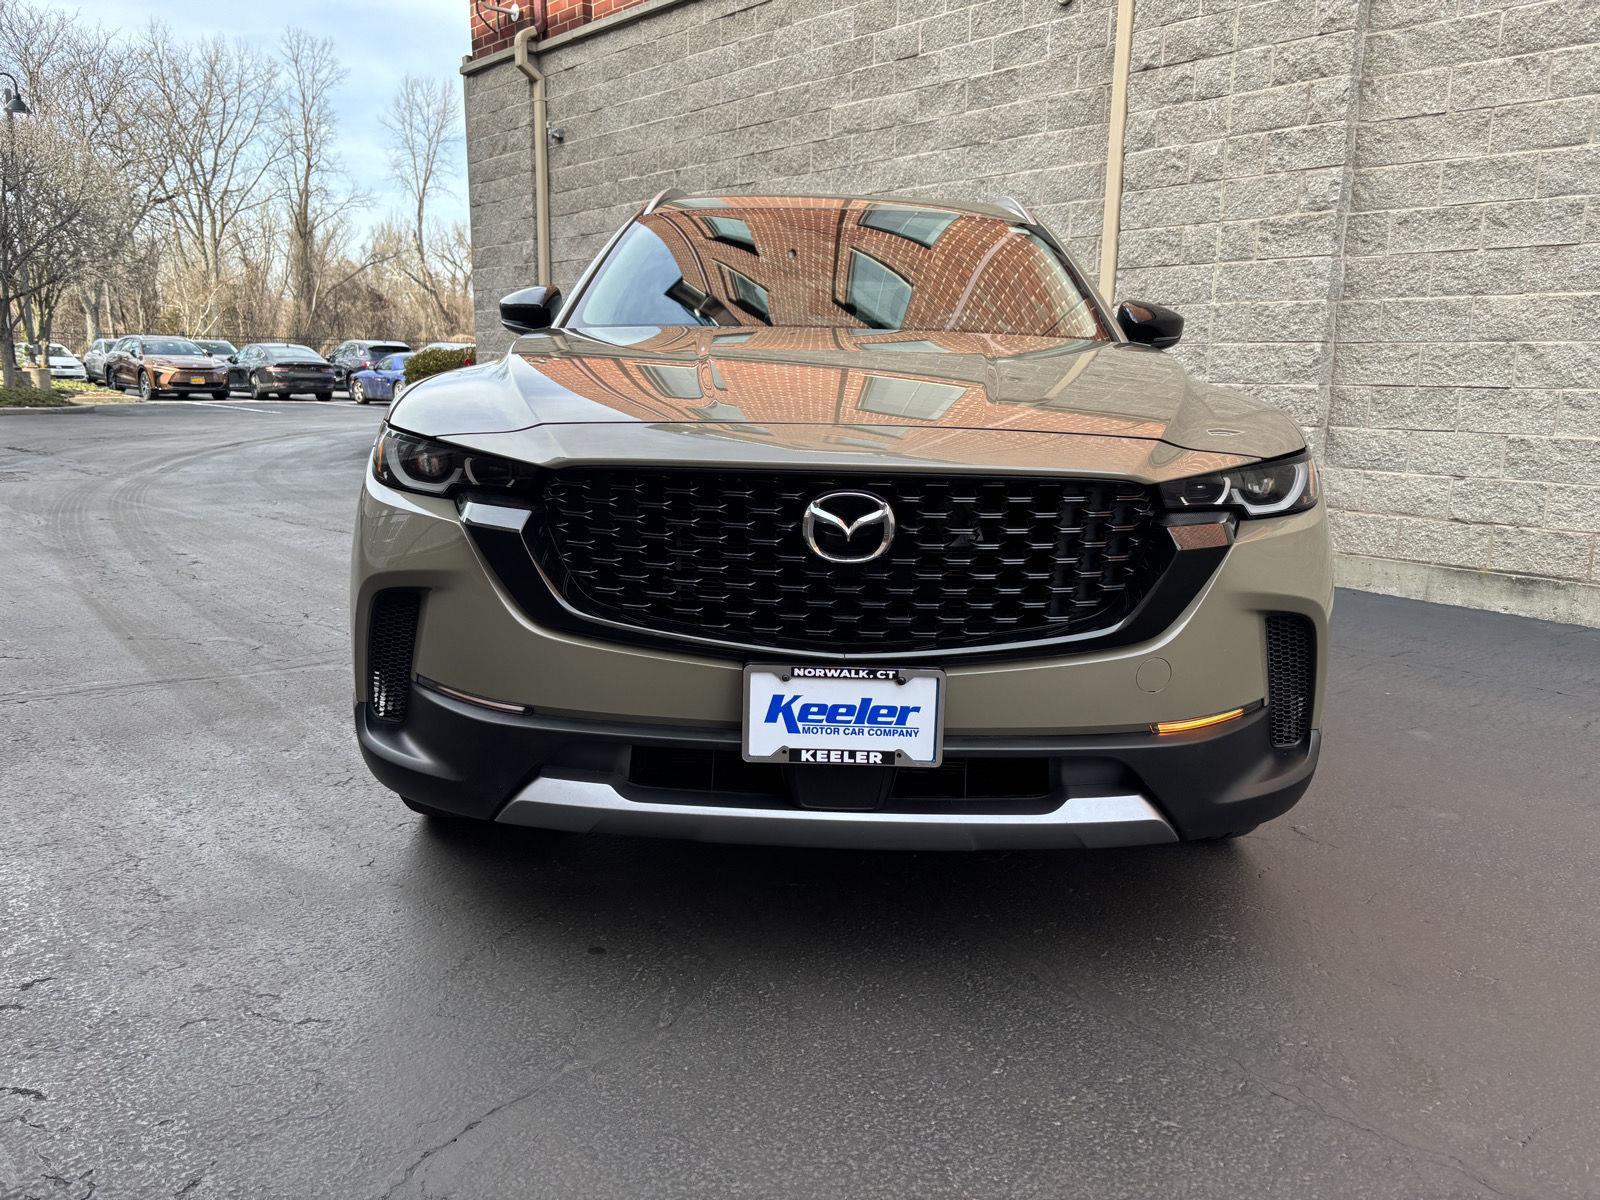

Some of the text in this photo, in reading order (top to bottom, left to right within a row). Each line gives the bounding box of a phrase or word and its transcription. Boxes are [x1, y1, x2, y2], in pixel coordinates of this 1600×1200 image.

[876, 670, 896, 680] CT
[764, 694, 921, 734] Keeler
[802, 726, 920, 738] MOTOR CAR COMPANY
[801, 749, 883, 764] KEELER
